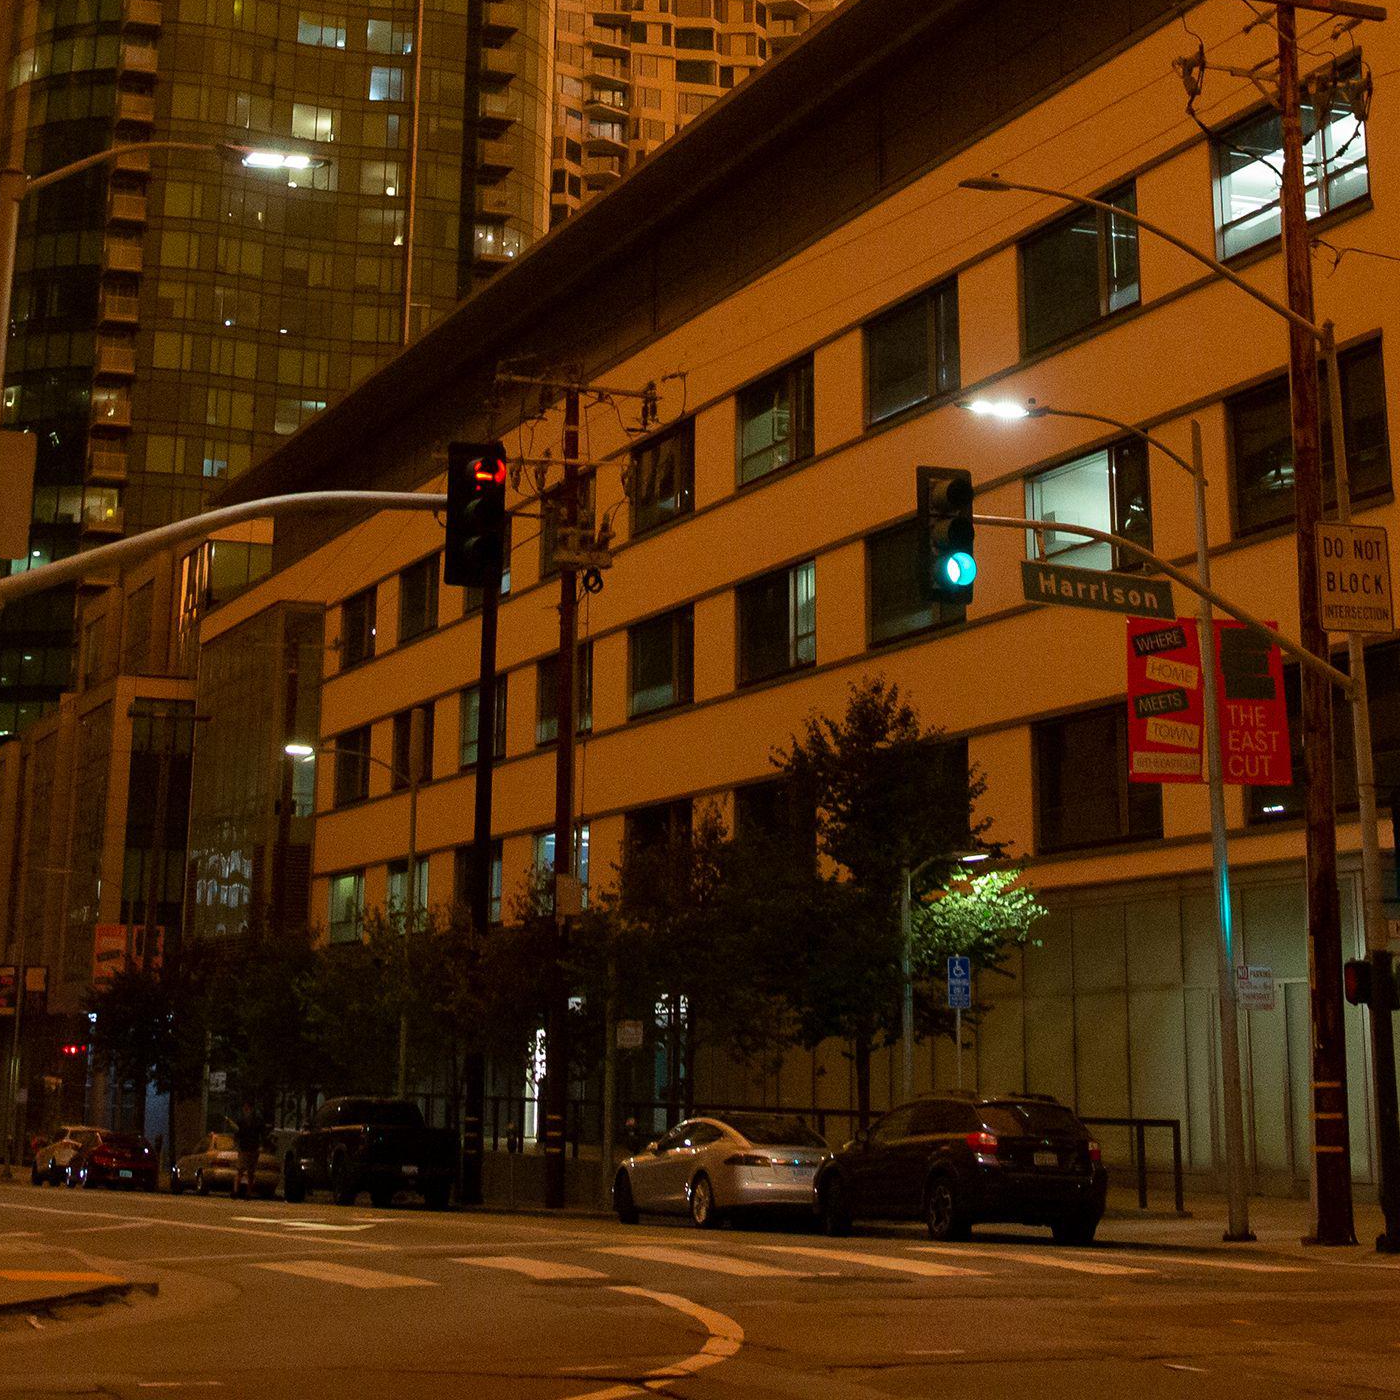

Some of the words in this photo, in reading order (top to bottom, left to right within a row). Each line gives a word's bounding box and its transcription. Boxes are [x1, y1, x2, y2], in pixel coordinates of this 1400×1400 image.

[1323, 536, 1343, 558] DO
[1353, 539, 1381, 561] NOT
[1038, 571, 1159, 610] Harrison
[1326, 570, 1384, 595] BLOCK
[1324, 604, 1389, 620] INTERSECTION
[1136, 630, 1181, 651] WHERE
[1150, 663, 1194, 683] HOME
[1138, 692, 1183, 712] MEETS
[1227, 704, 1267, 727] THE
[1153, 722, 1194, 742] TOWN
[1227, 729, 1280, 753] EAST
[1228, 753, 1273, 778] CUT
